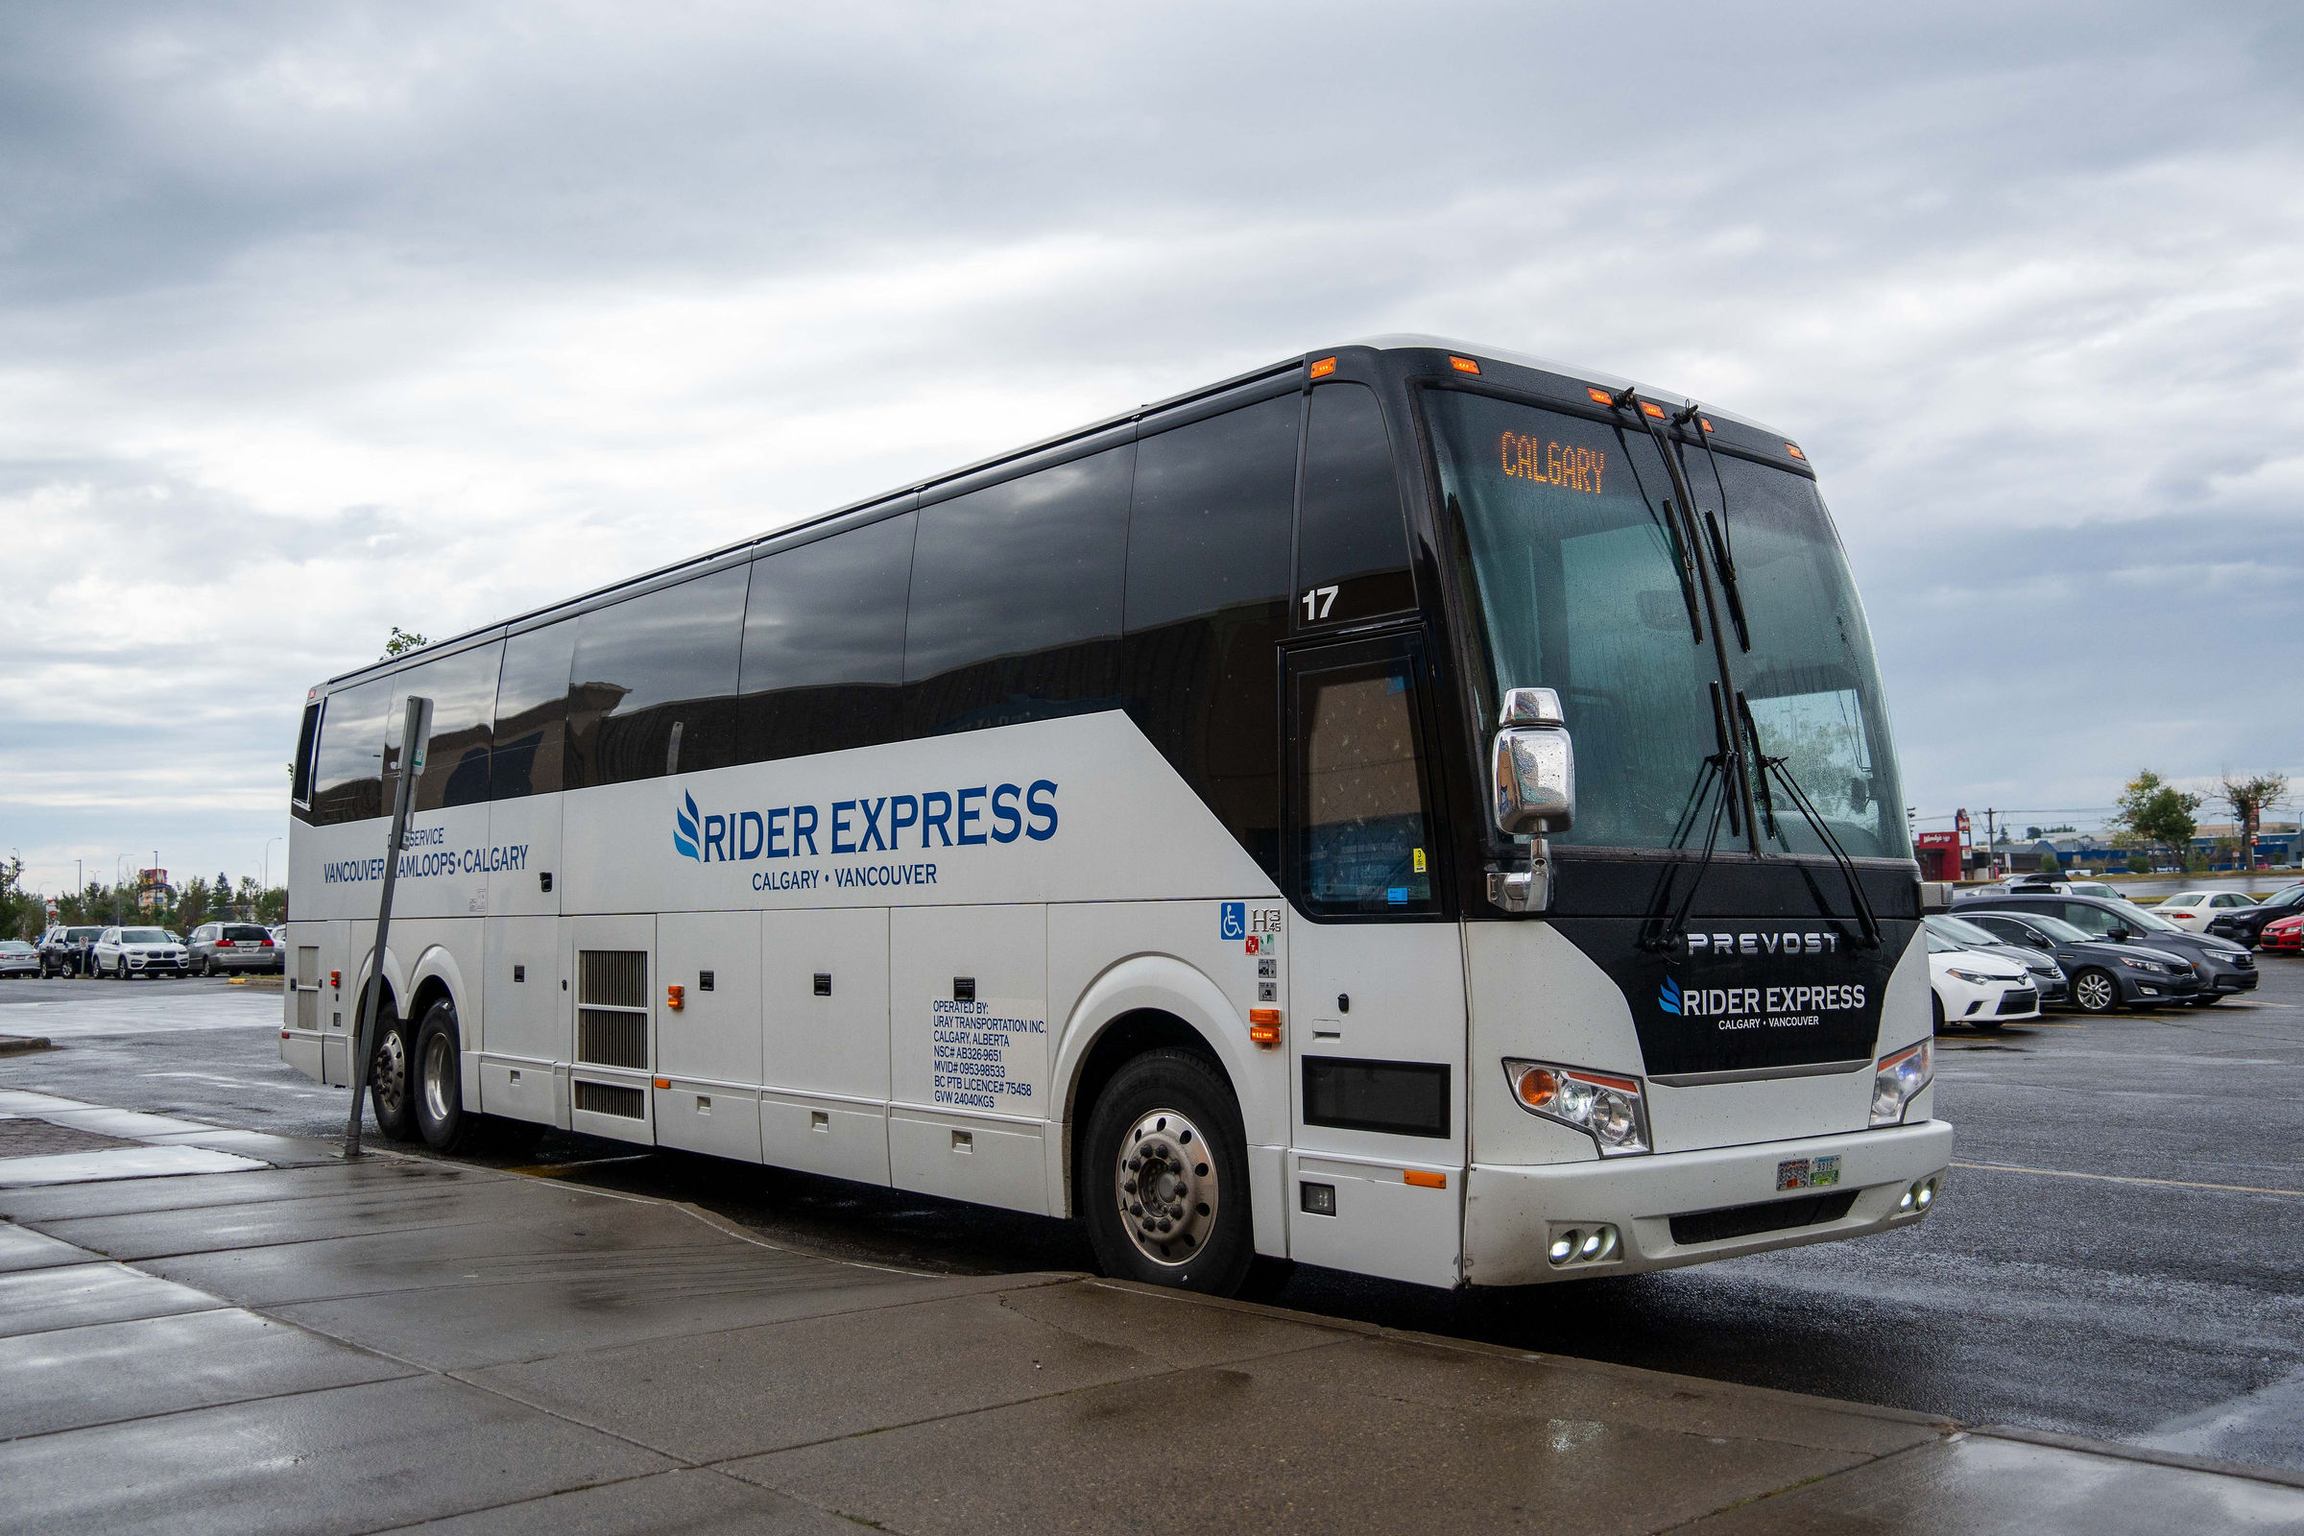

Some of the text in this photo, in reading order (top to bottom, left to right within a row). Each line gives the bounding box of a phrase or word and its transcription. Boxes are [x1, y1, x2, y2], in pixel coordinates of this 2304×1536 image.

[1501, 430, 1606, 494] CALGARY
[1302, 585, 1339, 621] 17
[703, 779, 1059, 863] RIDER EXPRESS
[408, 827, 445, 847] SERVICE
[323, 858, 385, 883] VANCOUVER
[463, 844, 529, 873] CALGARY
[751, 863, 938, 891] CALGARY VANCOUVER
[1686, 932, 1840, 955] PREVOST
[933, 1000, 989, 1014] OPERATED BY:
[1683, 984, 1866, 1016] RIDER EXPRESS
[933, 1015, 1047, 1033] URAY TRANSPORTATION INC.
[1718, 1016, 1819, 1030] CALGARY VANCOUVER
[933, 1030, 1010, 1047] CALGARY, ALBERTA
[934, 1045, 955, 1058] NSC#
[934, 1060, 959, 1074] MVID#
[934, 1075, 1032, 1097] BC PTB LICENCE# 75458
[934, 1090, 995, 1108] GVW 24040KGS
